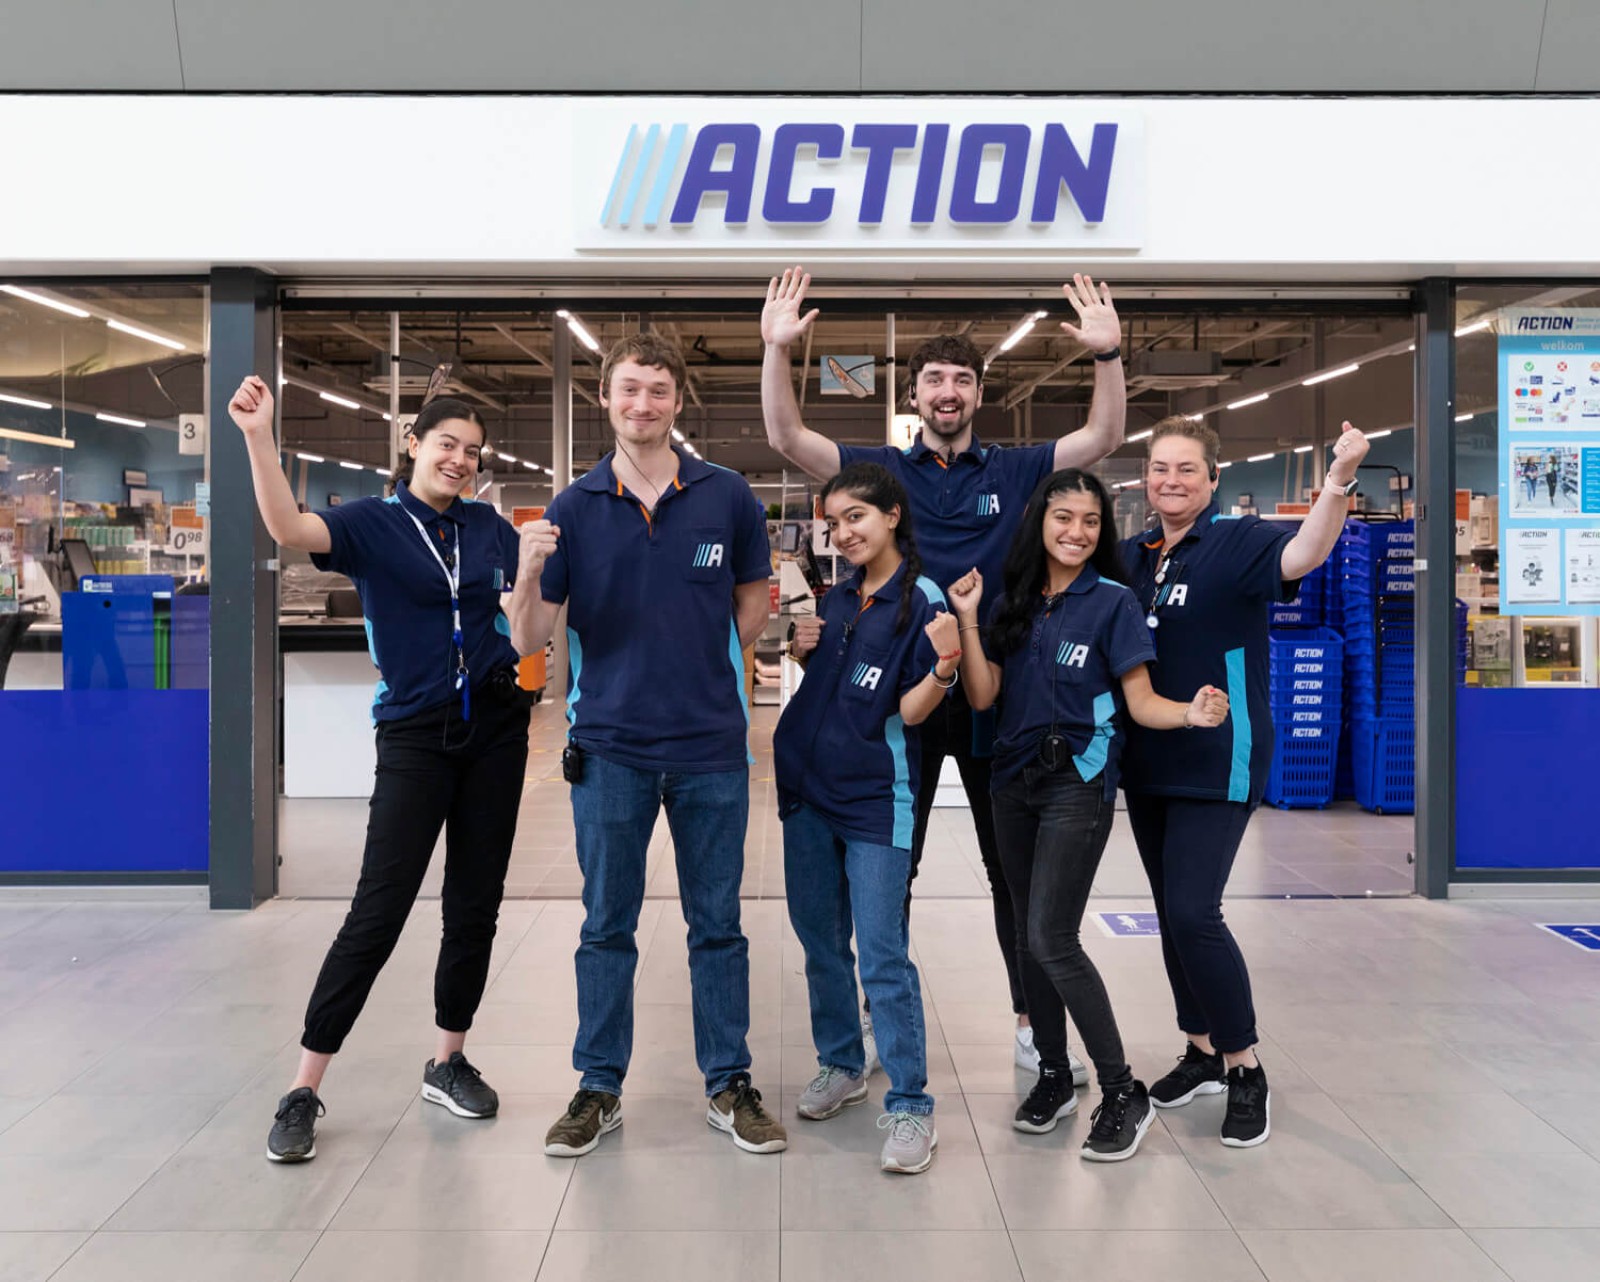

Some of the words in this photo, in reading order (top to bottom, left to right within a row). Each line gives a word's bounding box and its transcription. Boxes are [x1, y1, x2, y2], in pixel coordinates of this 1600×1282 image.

[670, 123, 1118, 224] ACTION
[1518, 316, 1574, 330] ACTION
[1540, 340, 1585, 351] welkom
[184, 423, 196, 440] 3
[403, 422, 414, 439] 2
[905, 424, 911, 440] 1
[1521, 530, 1548, 538] ACTION
[1273, 612, 1302, 622] ACTION
[1294, 648, 1324, 658] ACTION
[1294, 663, 1323, 673] ACTION
[1293, 680, 1323, 690] ACTION
[1292, 694, 1323, 705] ACTION
[1292, 711, 1322, 722] ACTION
[1292, 727, 1322, 738] ACTION
